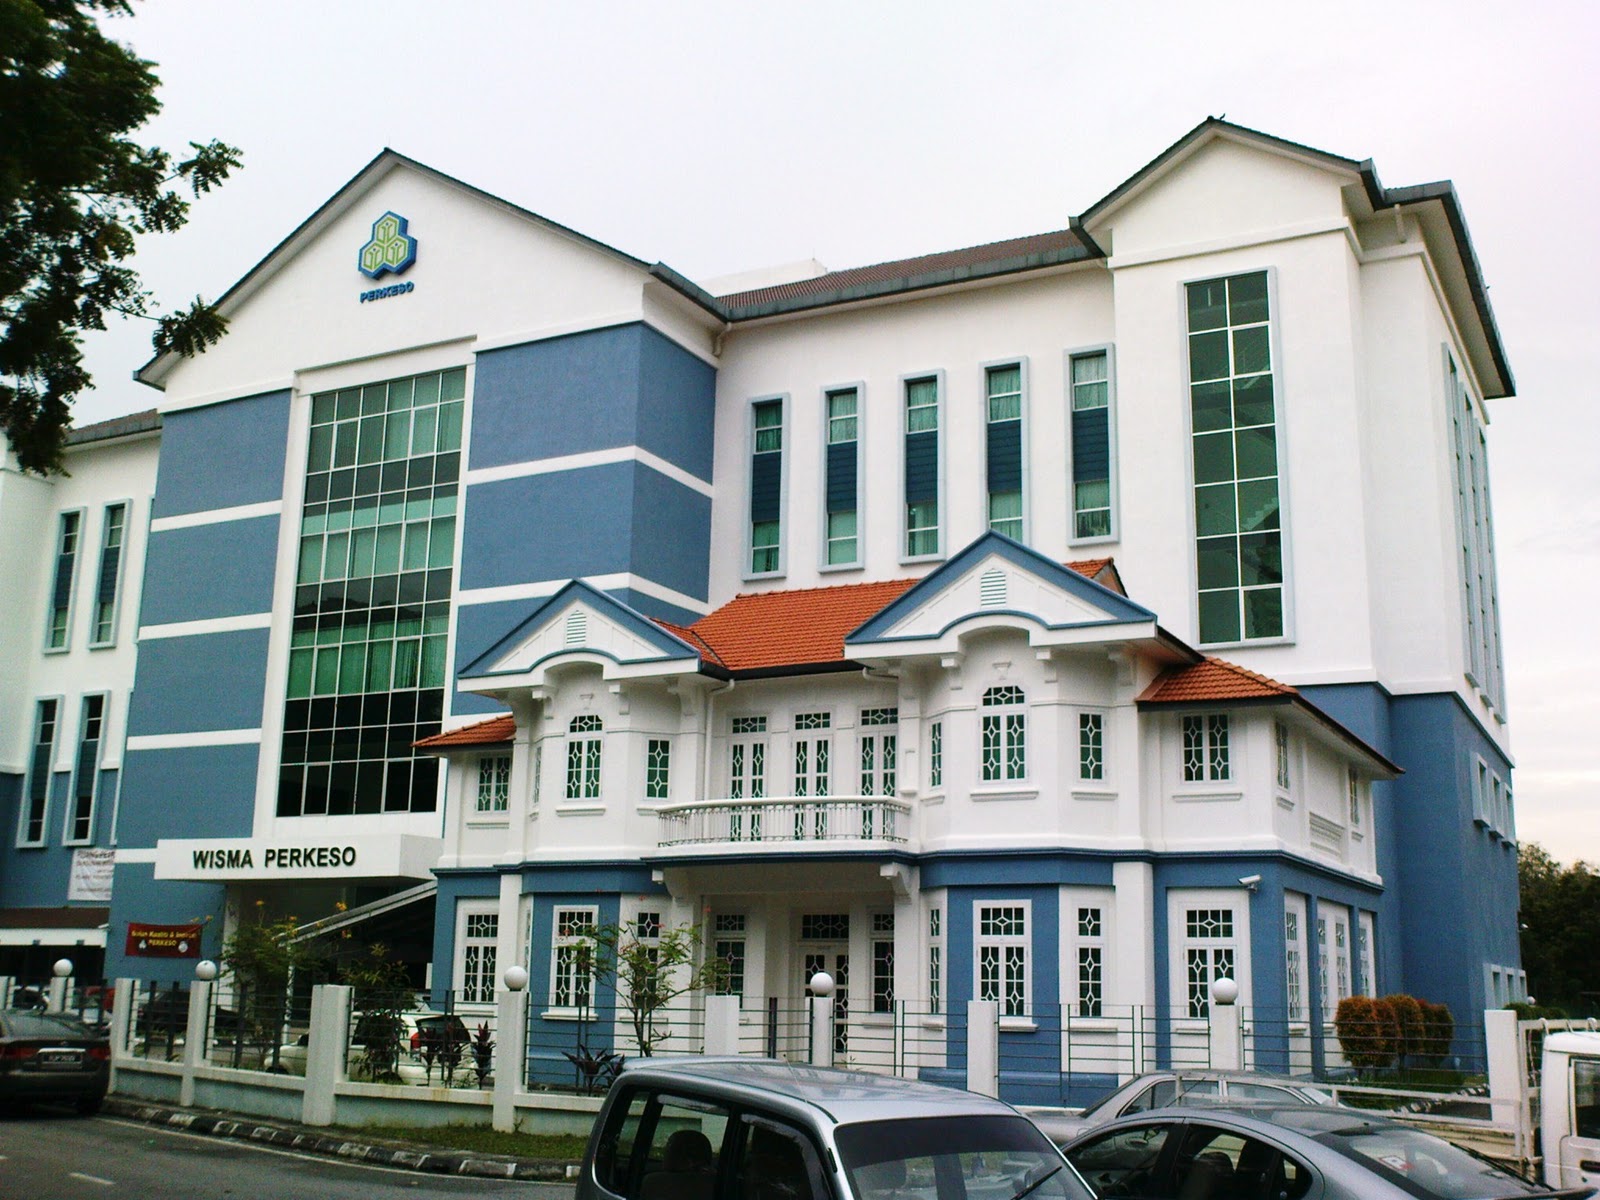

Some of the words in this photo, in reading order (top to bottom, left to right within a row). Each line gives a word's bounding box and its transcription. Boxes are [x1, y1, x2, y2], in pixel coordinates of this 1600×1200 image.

[360, 281, 414, 303] PERKESO
[193, 849, 254, 869] WISMA
[264, 846, 357, 868] PERKESO
